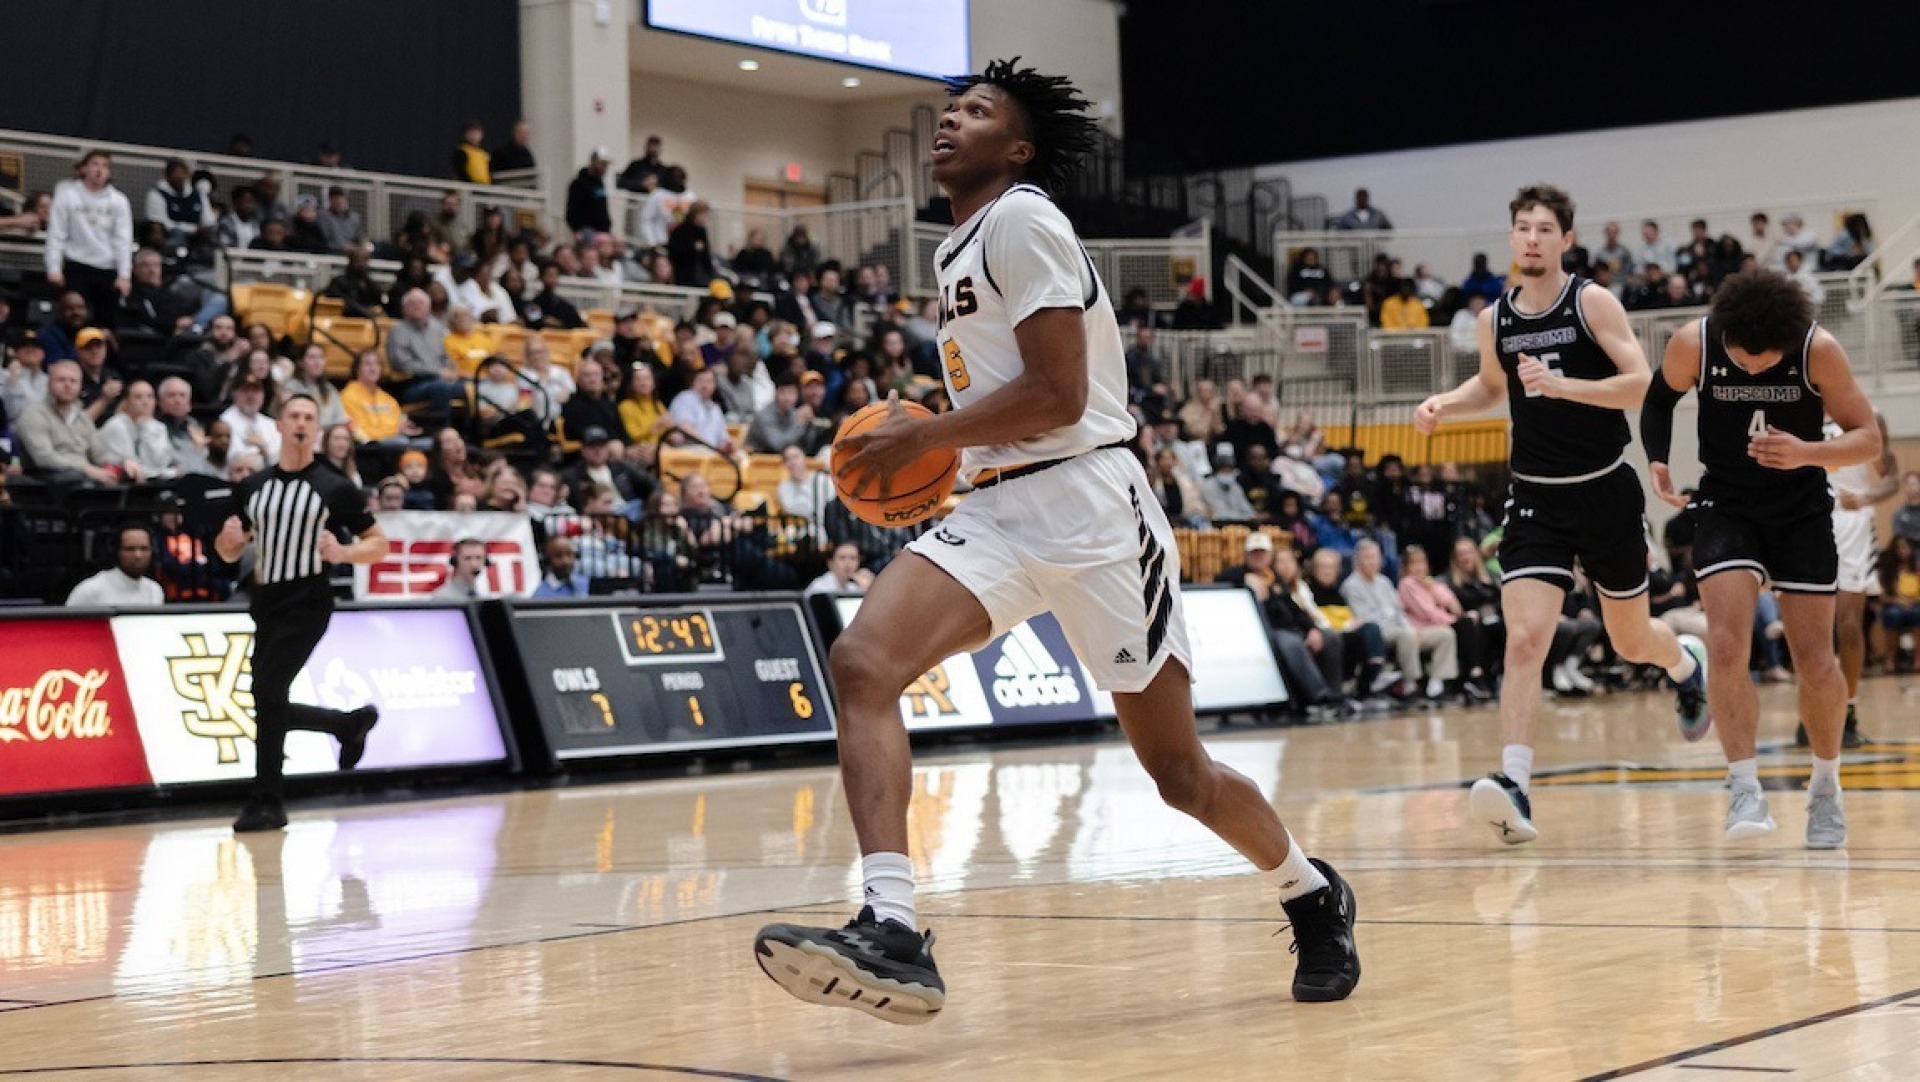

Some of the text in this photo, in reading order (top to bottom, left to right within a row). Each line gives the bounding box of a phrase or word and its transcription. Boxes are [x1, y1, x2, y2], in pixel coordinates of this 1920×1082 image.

[940, 276, 978, 330] LS
[1501, 326, 1577, 354] LIPSCOMB
[1712, 385, 1801, 402] LIPSCOMB
[1747, 408, 1769, 438] 4
[368, 540, 525, 595] ESN
[632, 614, 713, 654] 12:47
[552, 666, 600, 692] OWLS
[754, 657, 801, 682] GUEST
[0, 668, 112, 742] a-Cola
[789, 682, 814, 719] 6
[992, 672, 1082, 708] adidas
[590, 692, 616, 727] 7
[687, 695, 705, 727] 1
